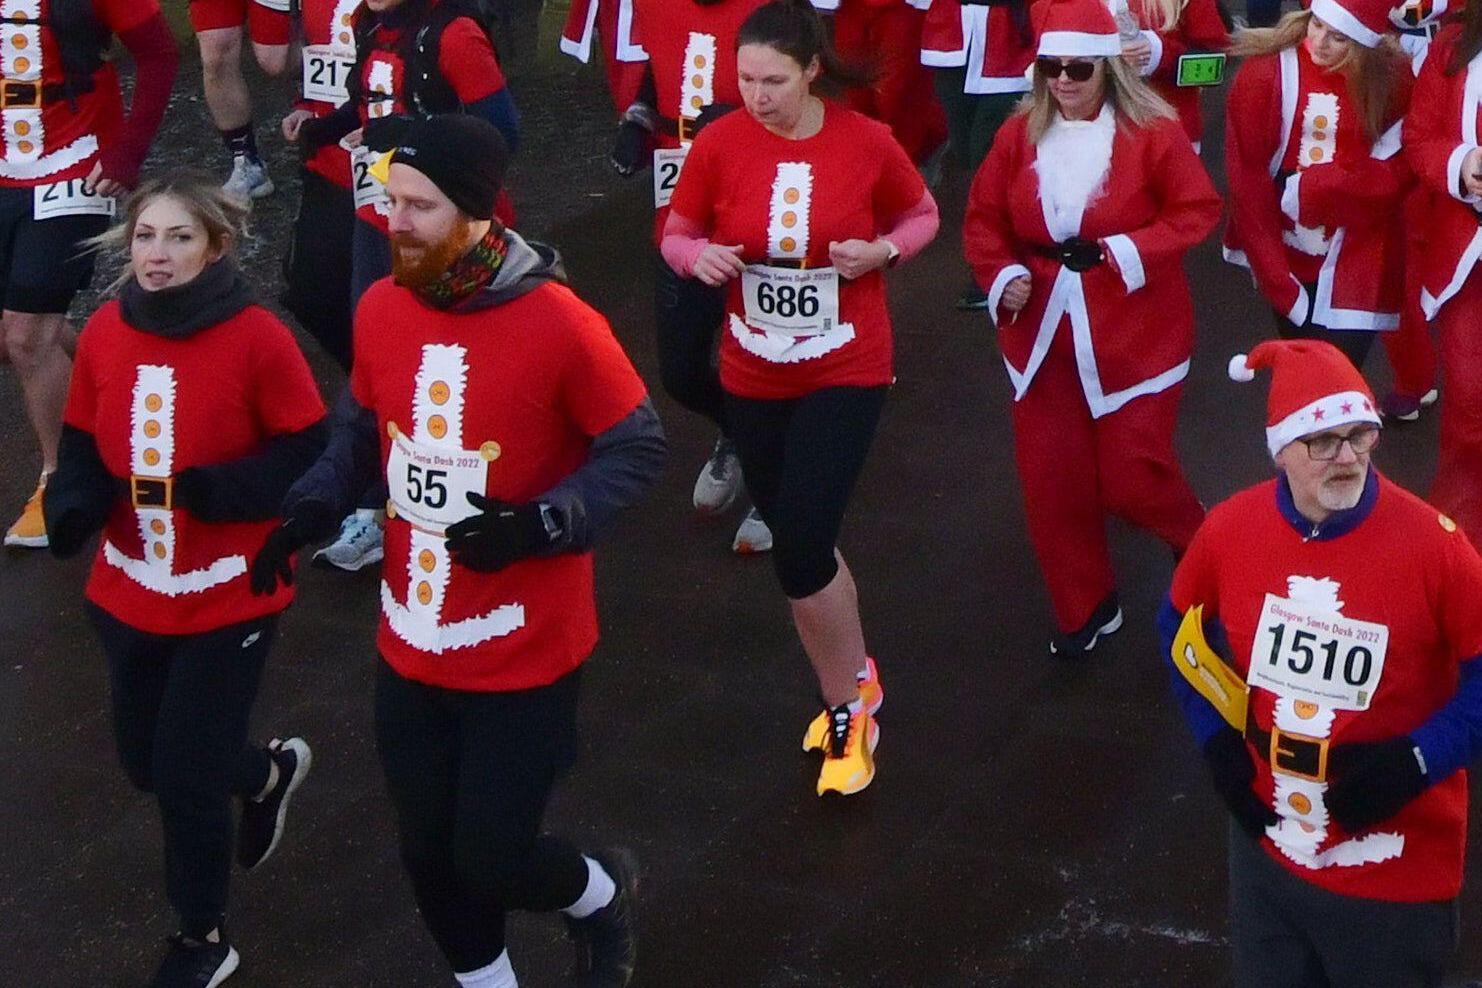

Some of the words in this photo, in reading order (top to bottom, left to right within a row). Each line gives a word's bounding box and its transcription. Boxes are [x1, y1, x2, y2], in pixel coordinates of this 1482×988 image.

[757, 282, 819, 317] 686
[434, 455, 454, 466] Dash
[456, 457, 480, 469] 2022
[407, 463, 447, 509] 55
[1270, 603, 1303, 622] Glasgow
[1306, 615, 1330, 631] Santa
[1332, 623, 1353, 637] Dash
[1356, 629, 1380, 643] 2022
[1267, 623, 1372, 686] 1510
